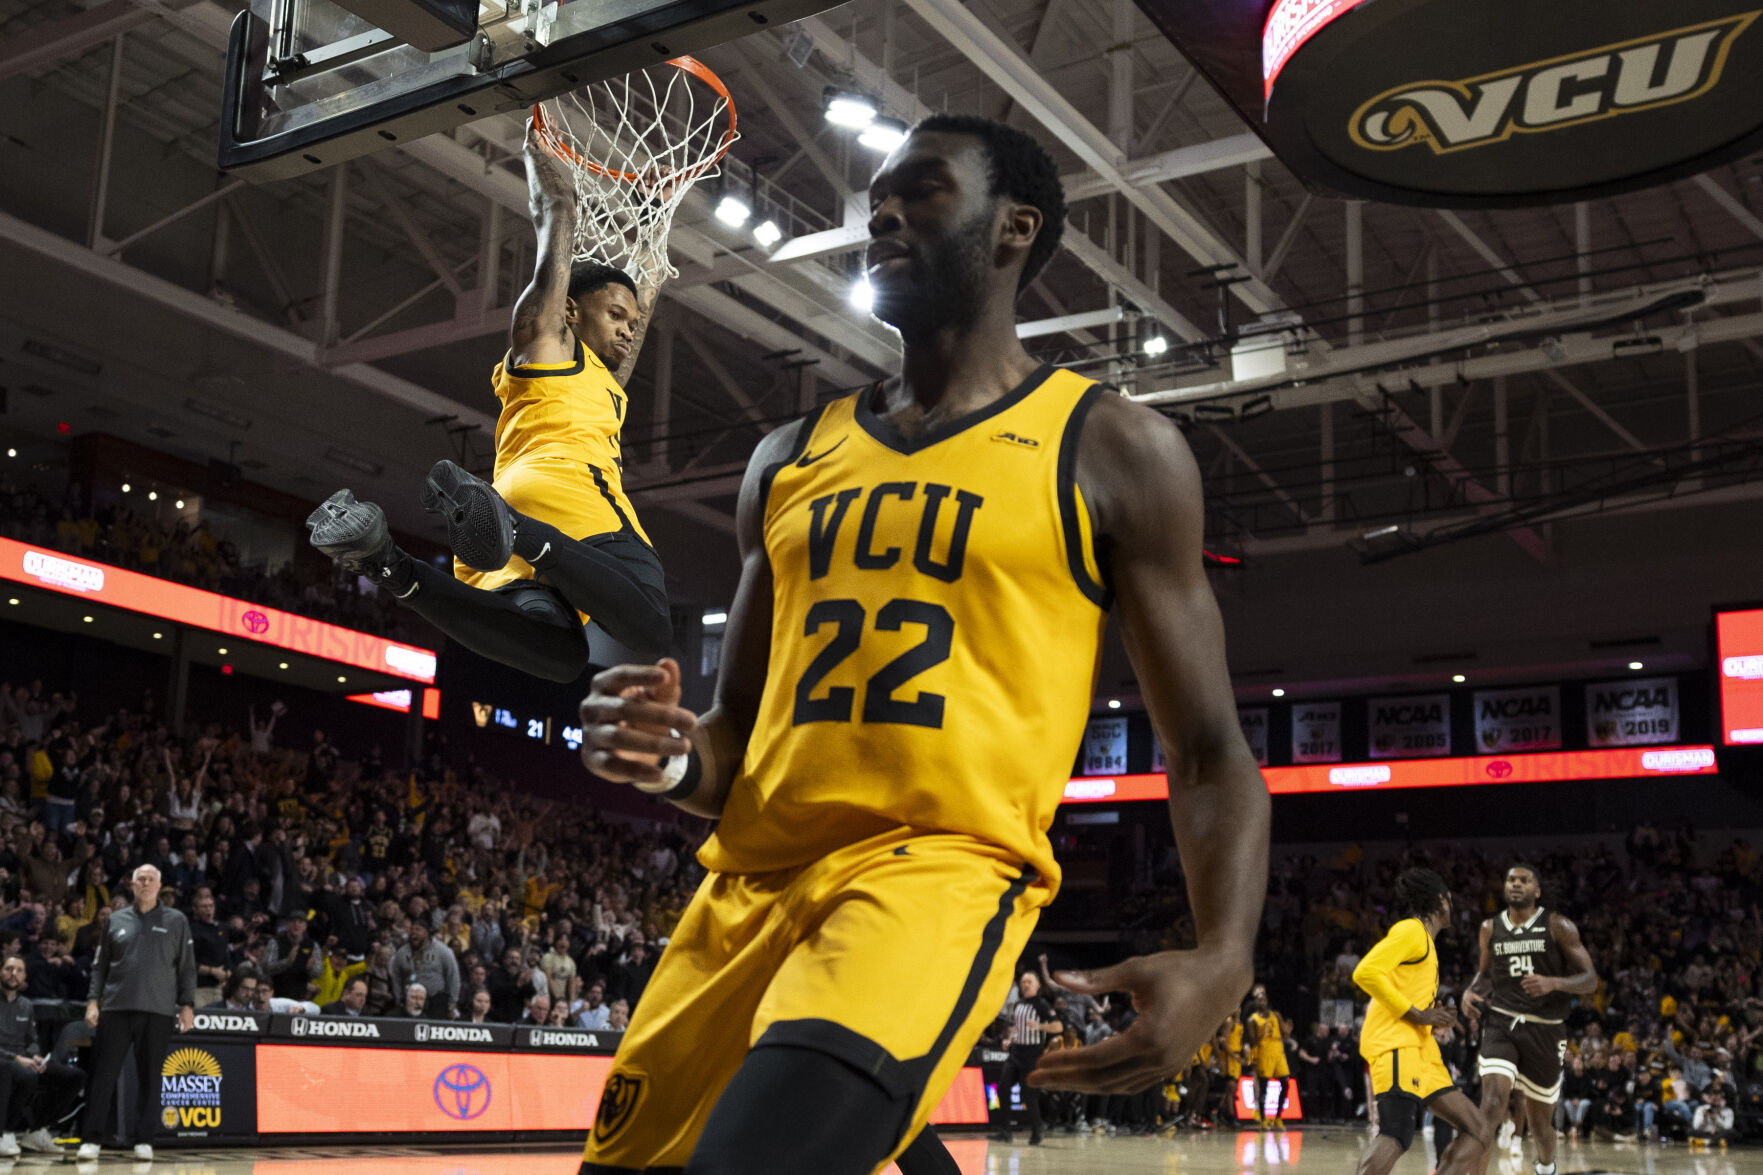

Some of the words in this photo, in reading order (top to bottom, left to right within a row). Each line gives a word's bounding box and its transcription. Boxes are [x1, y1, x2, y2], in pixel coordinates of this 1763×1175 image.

[1366, 29, 1722, 145] VCU
[808, 481, 985, 584] VCU
[792, 598, 955, 730] 22
[1481, 696, 1552, 720] NCAA
[1595, 687, 1669, 713] NCAA
[1375, 704, 1443, 727] NCAA
[1510, 726, 1552, 743] 2017
[1625, 719, 1669, 736] 2019
[1300, 743, 1334, 757] 2017
[1509, 955, 1534, 977] 24
[180, 1014, 259, 1032] ONDA
[308, 1021, 380, 1038] HONDA
[430, 1027, 494, 1042] HONDA
[543, 1033, 599, 1047] HONDA
[161, 1076, 222, 1092] MASSEY
[179, 1107, 221, 1127] VCU
